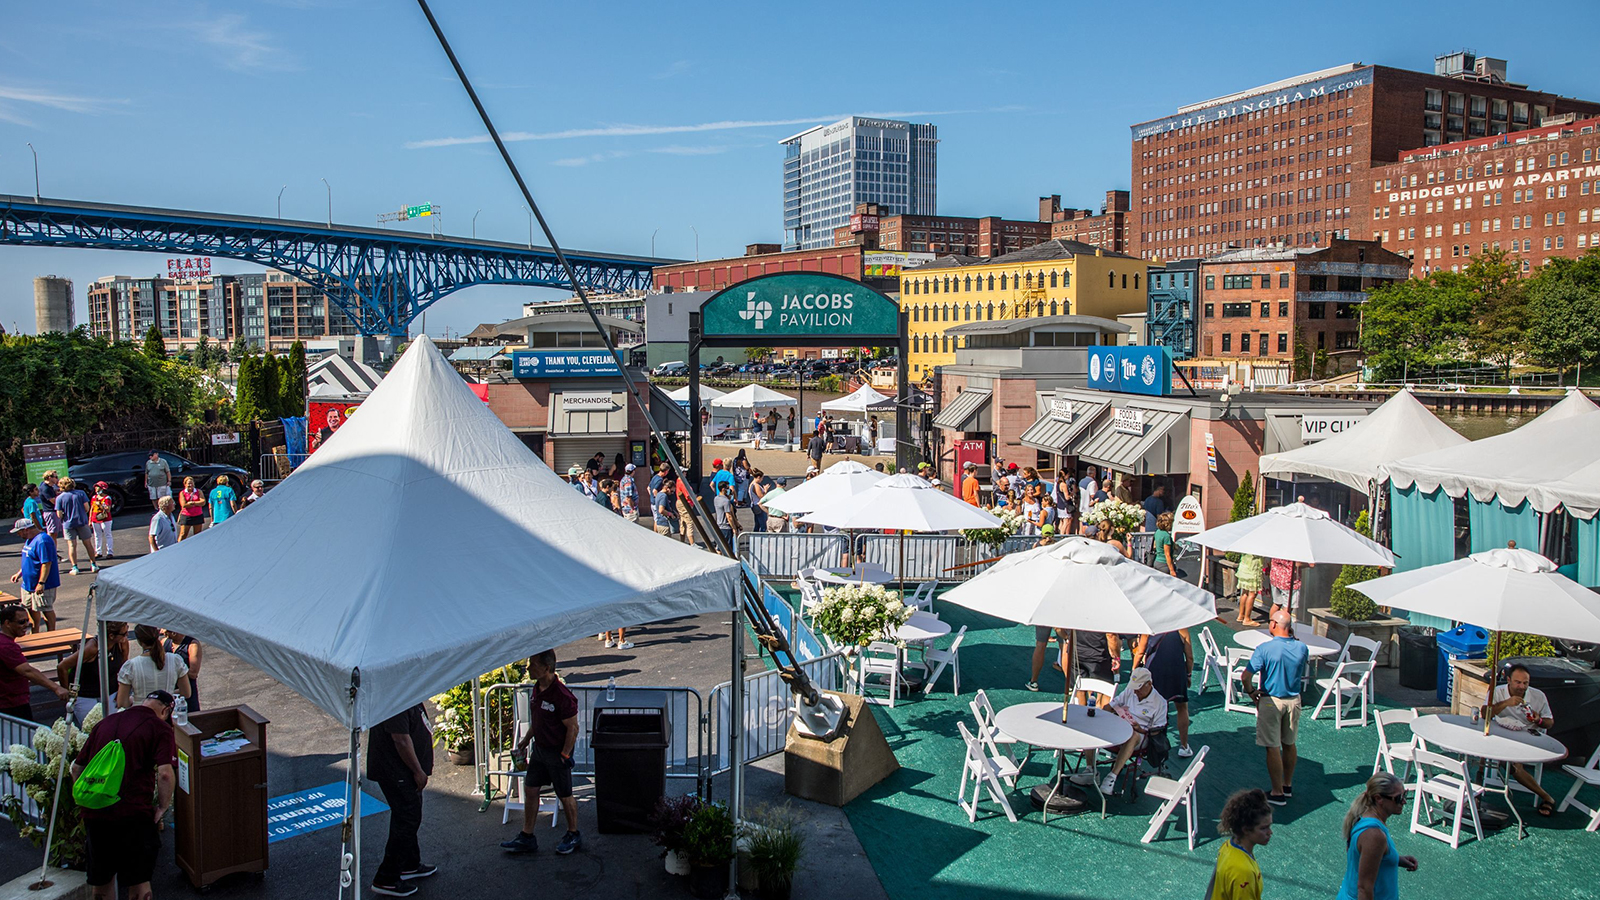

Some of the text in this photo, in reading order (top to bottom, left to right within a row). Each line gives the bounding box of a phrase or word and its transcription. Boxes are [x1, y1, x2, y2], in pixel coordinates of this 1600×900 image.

[1167, 114, 1206, 130] THE
[1218, 85, 1325, 119] BINGHAM
[1388, 178, 1505, 203] BRIDGEVIEW
[167, 257, 211, 269] FLATS
[168, 271, 188, 279] EAST
[781, 293, 854, 310] JACOBS
[780, 313, 853, 326] PAVILION
[545, 356, 565, 365] THANK
[566, 356, 581, 366] YOU,
[1121, 358, 1137, 380] Lite
[1054, 400, 1064, 409] FOOD
[1051, 408, 1071, 419] BEVERAGES
[1119, 409, 1133, 420] FOOD
[1115, 418, 1142, 431] BEVERAGES
[1304, 420, 1328, 433] VIP
[962, 442, 983, 450] ATM
[217, 490, 222, 498] 3
[1180, 502, 1199, 510] Tito's
[308, 792, 326, 800] VIP
[268, 797, 306, 811] HOSPIT
[291, 812, 344, 829] WELCOME
[275, 824, 293, 834] TO
